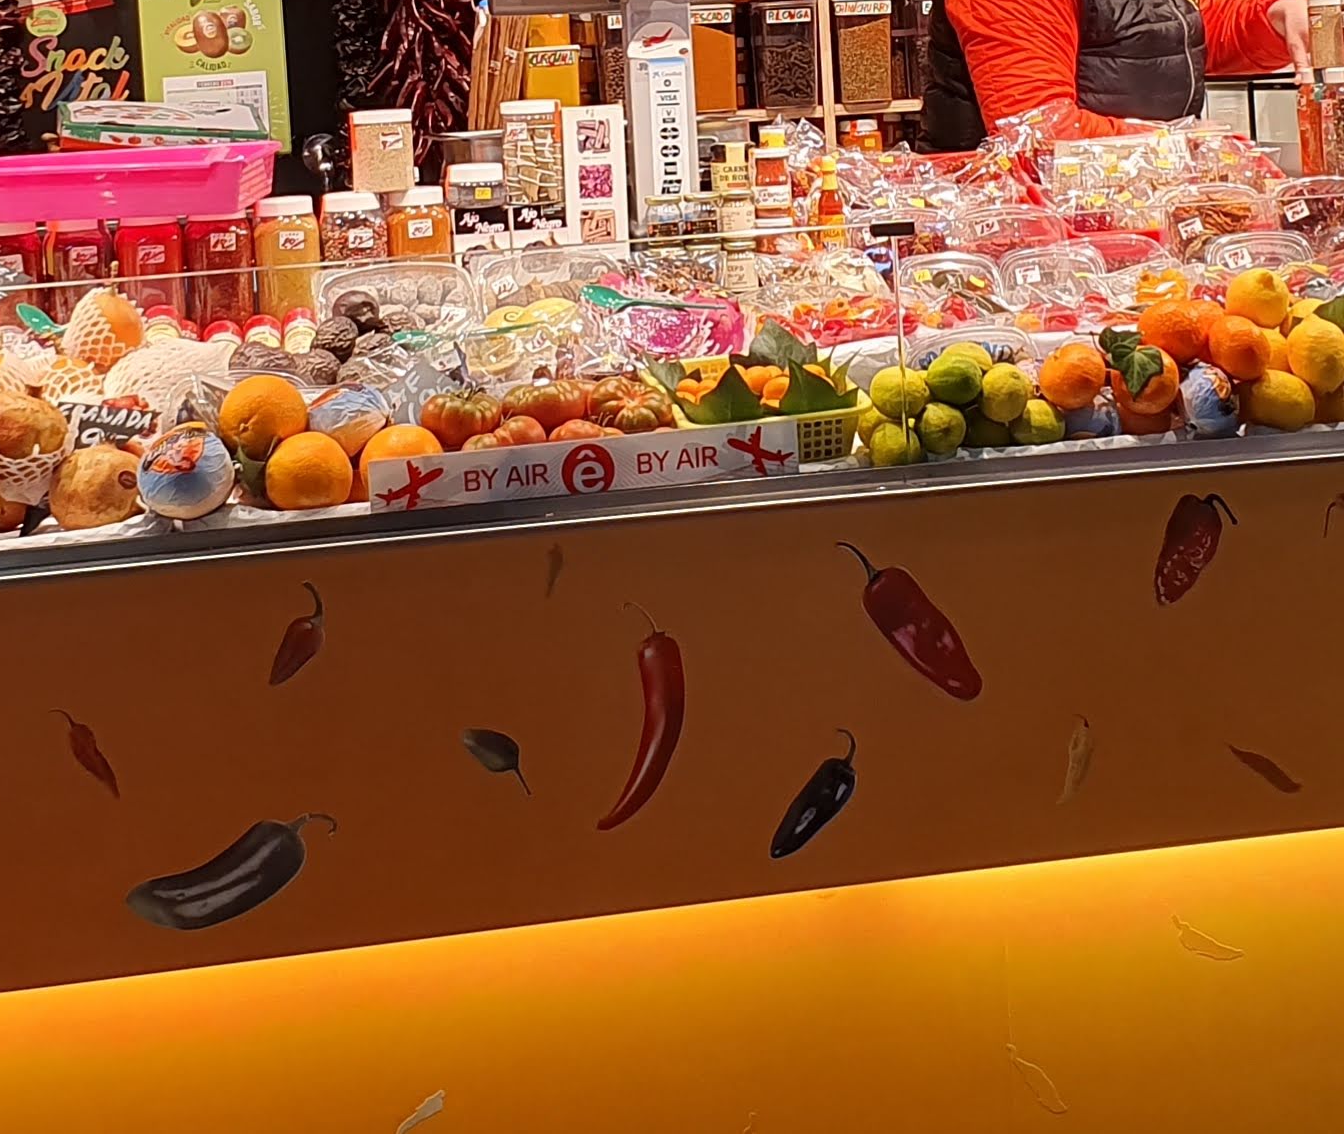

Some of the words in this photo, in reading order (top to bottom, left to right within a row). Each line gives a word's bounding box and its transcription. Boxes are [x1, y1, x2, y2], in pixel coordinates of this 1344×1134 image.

[21, 34, 130, 78] Snack
[195, 58, 228, 72] CALIDAD
[459, 211, 480, 227] Ajo
[517, 207, 538, 223] Ajo
[474, 220, 505, 234] Negro
[531, 217, 563, 231] Negro
[463, 469, 499, 492] BY
[507, 462, 549, 487] AIR
[637, 449, 671, 475] BY
[676, 445, 718, 470] AIR
